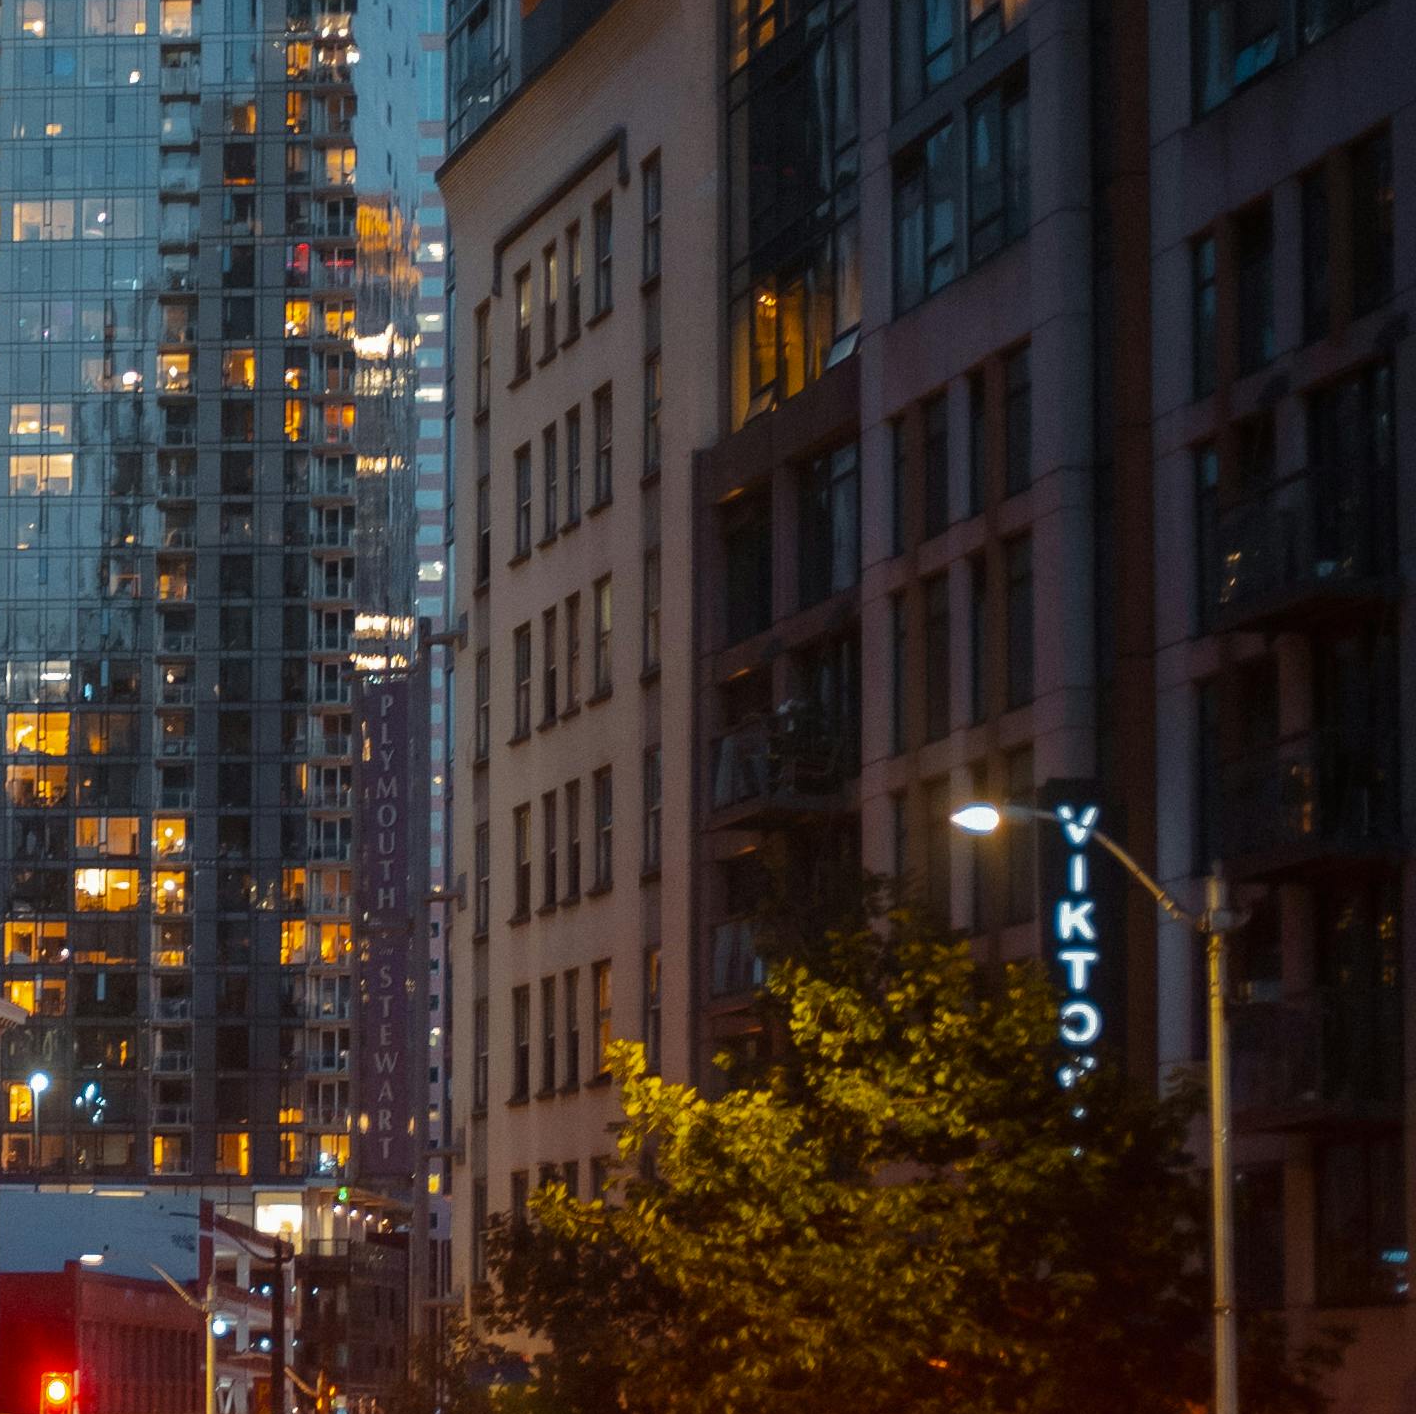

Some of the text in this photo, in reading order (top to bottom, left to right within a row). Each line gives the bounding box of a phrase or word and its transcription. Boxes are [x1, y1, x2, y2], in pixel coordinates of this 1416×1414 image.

[375, 694, 398, 910] PLYMOUTH
[373, 966, 399, 1160] STEWART
[1057, 804, 1101, 1117] VIKTO
